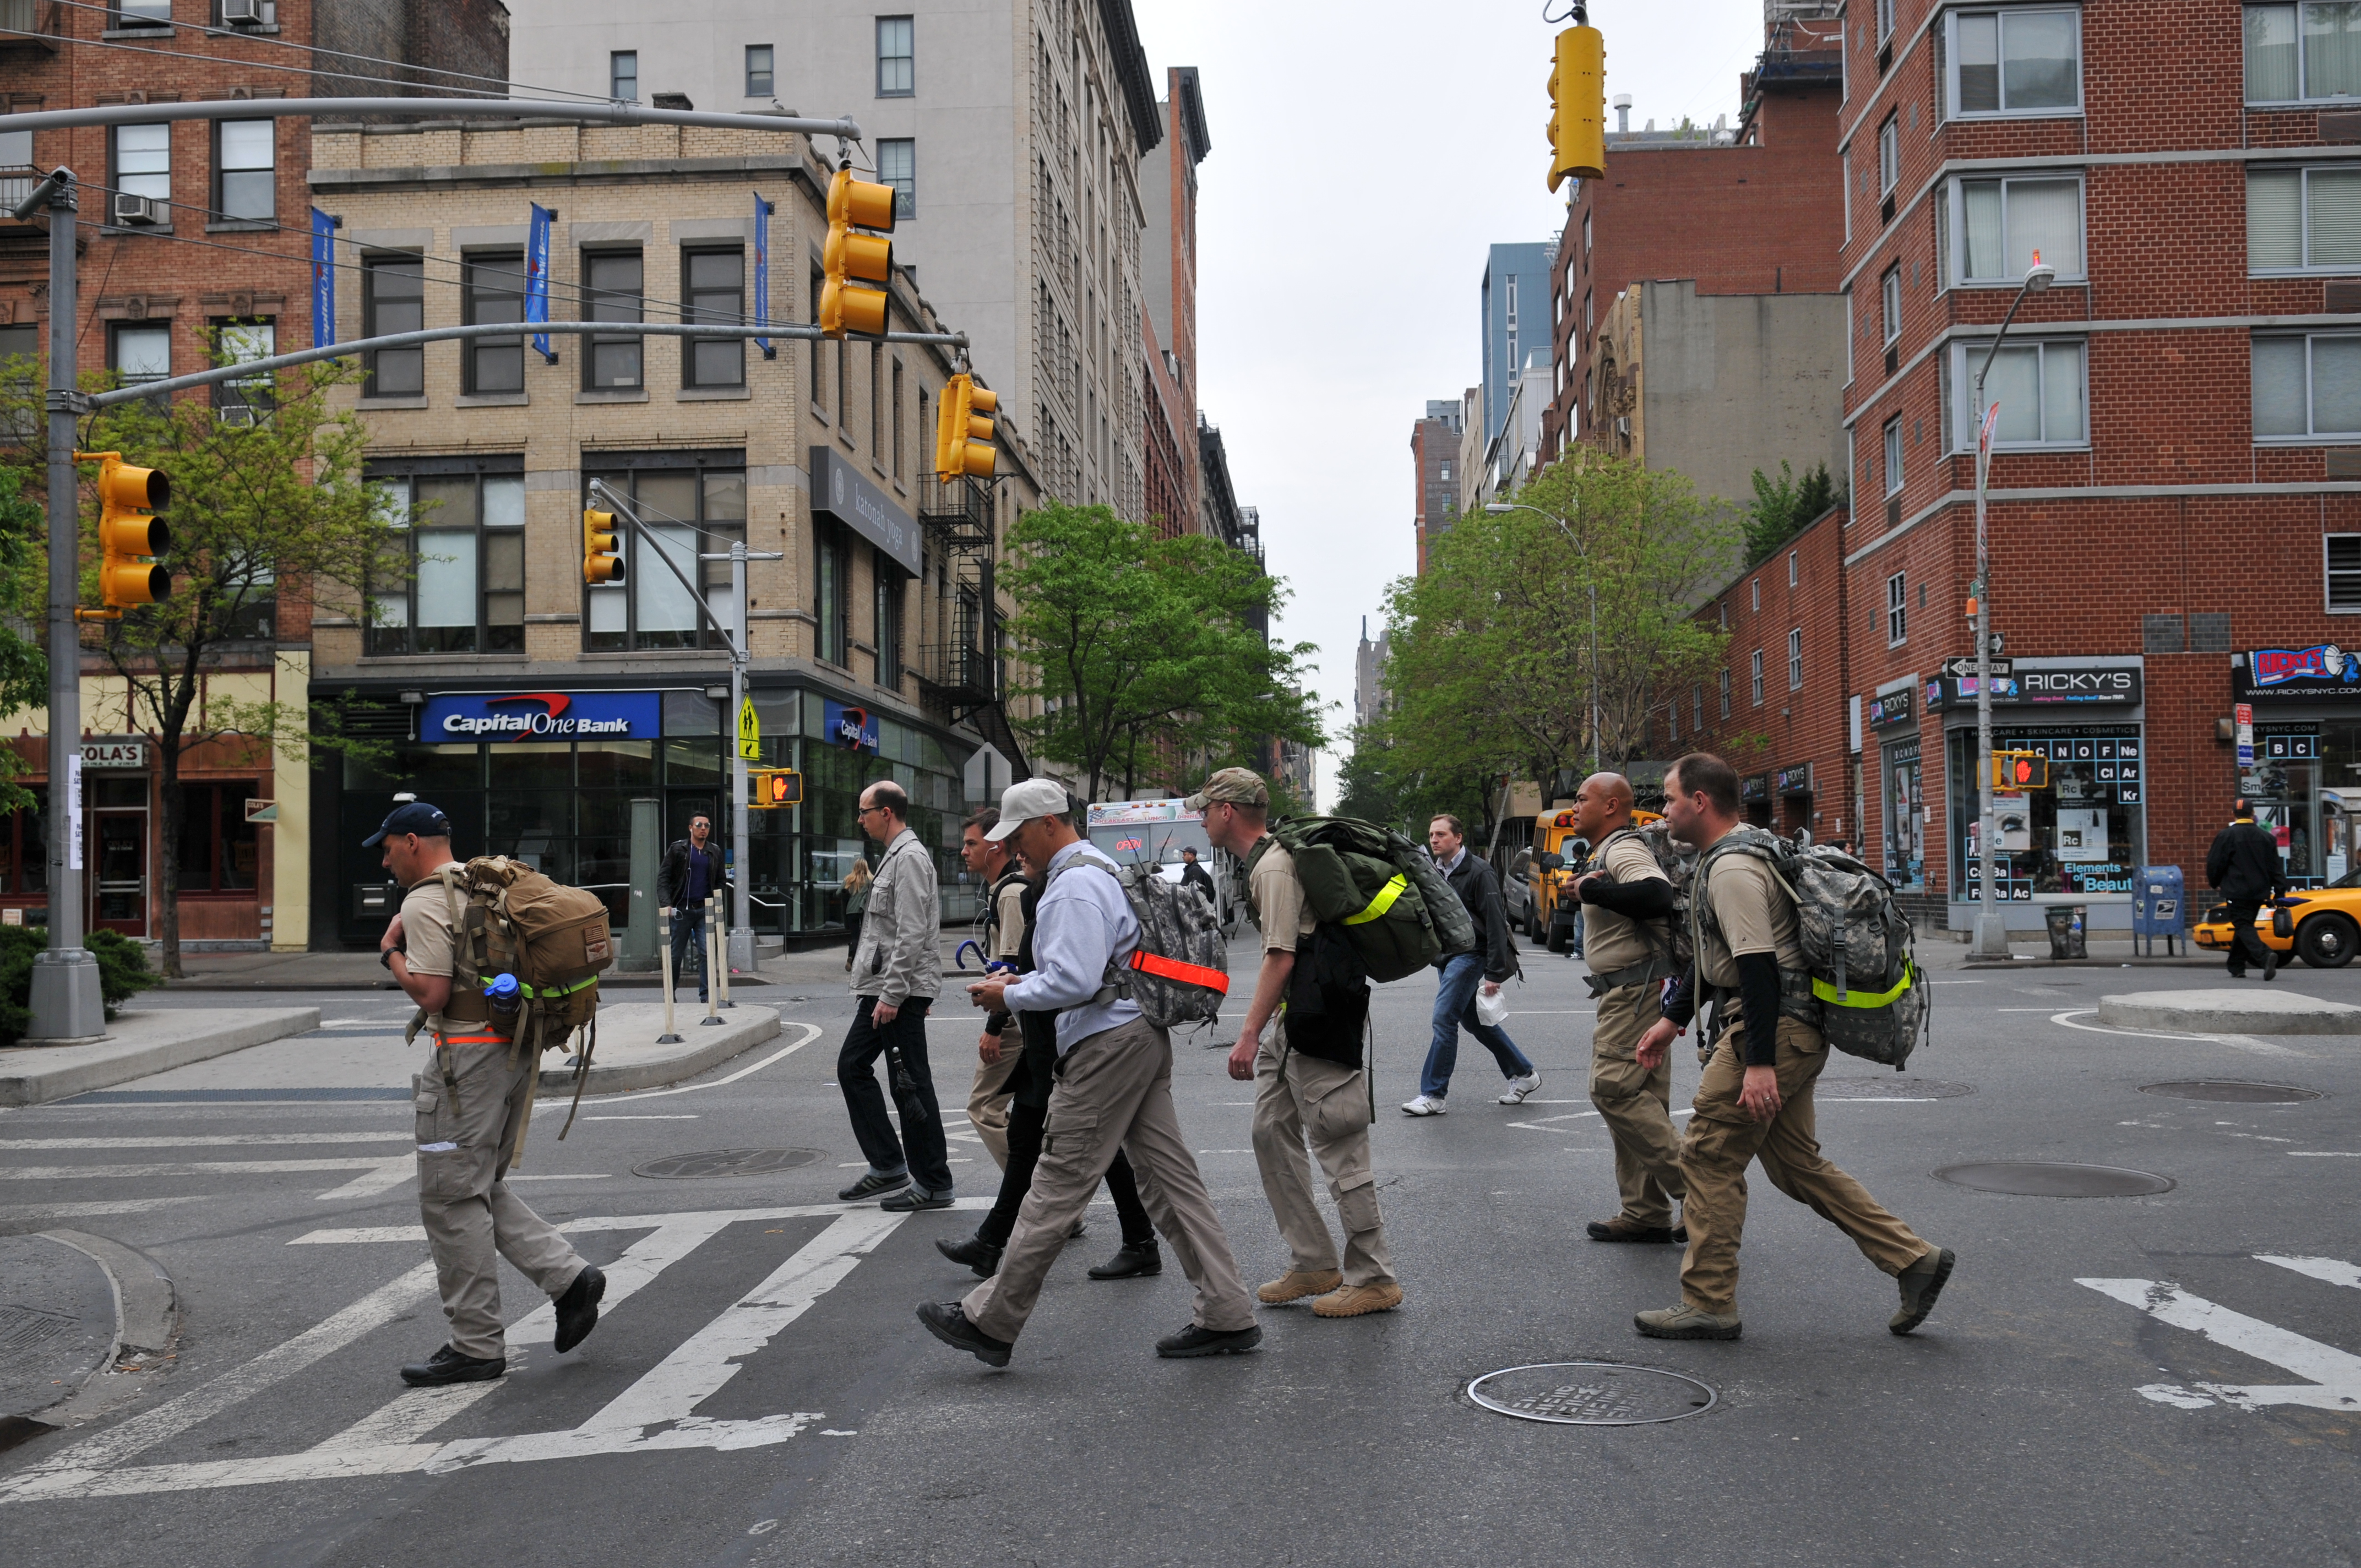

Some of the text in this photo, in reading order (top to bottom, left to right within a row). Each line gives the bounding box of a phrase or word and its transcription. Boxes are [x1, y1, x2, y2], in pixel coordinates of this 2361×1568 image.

[856, 483, 903, 550] katonah yoga
[2258, 649, 2322, 674] RICKY'S
[1957, 663, 1977, 672] ONE
[2025, 673, 2131, 690] RICKY'S
[577, 718, 629, 733] Bank
[1971, 728, 2017, 737] HCARE
[2058, 747, 2067, 756] N
[2079, 746, 2090, 756] O
[2102, 746, 2110, 756] F
[2120, 746, 2137, 756] Ne
[2273, 743, 2306, 754] B C
[2122, 767, 2136, 778] Ar
[2062, 785, 2077, 793] Rc
[2243, 782, 2261, 791] Sm
[2123, 791, 2138, 801] Kr
[1116, 838, 1143, 851] OPEN
[2063, 835, 2079, 845] Rc
[2064, 863, 2121, 873] Elements
[2072, 873, 2085, 881] of
[2086, 876, 2132, 891] Beaut
[2013, 888, 2029, 899] Ac
